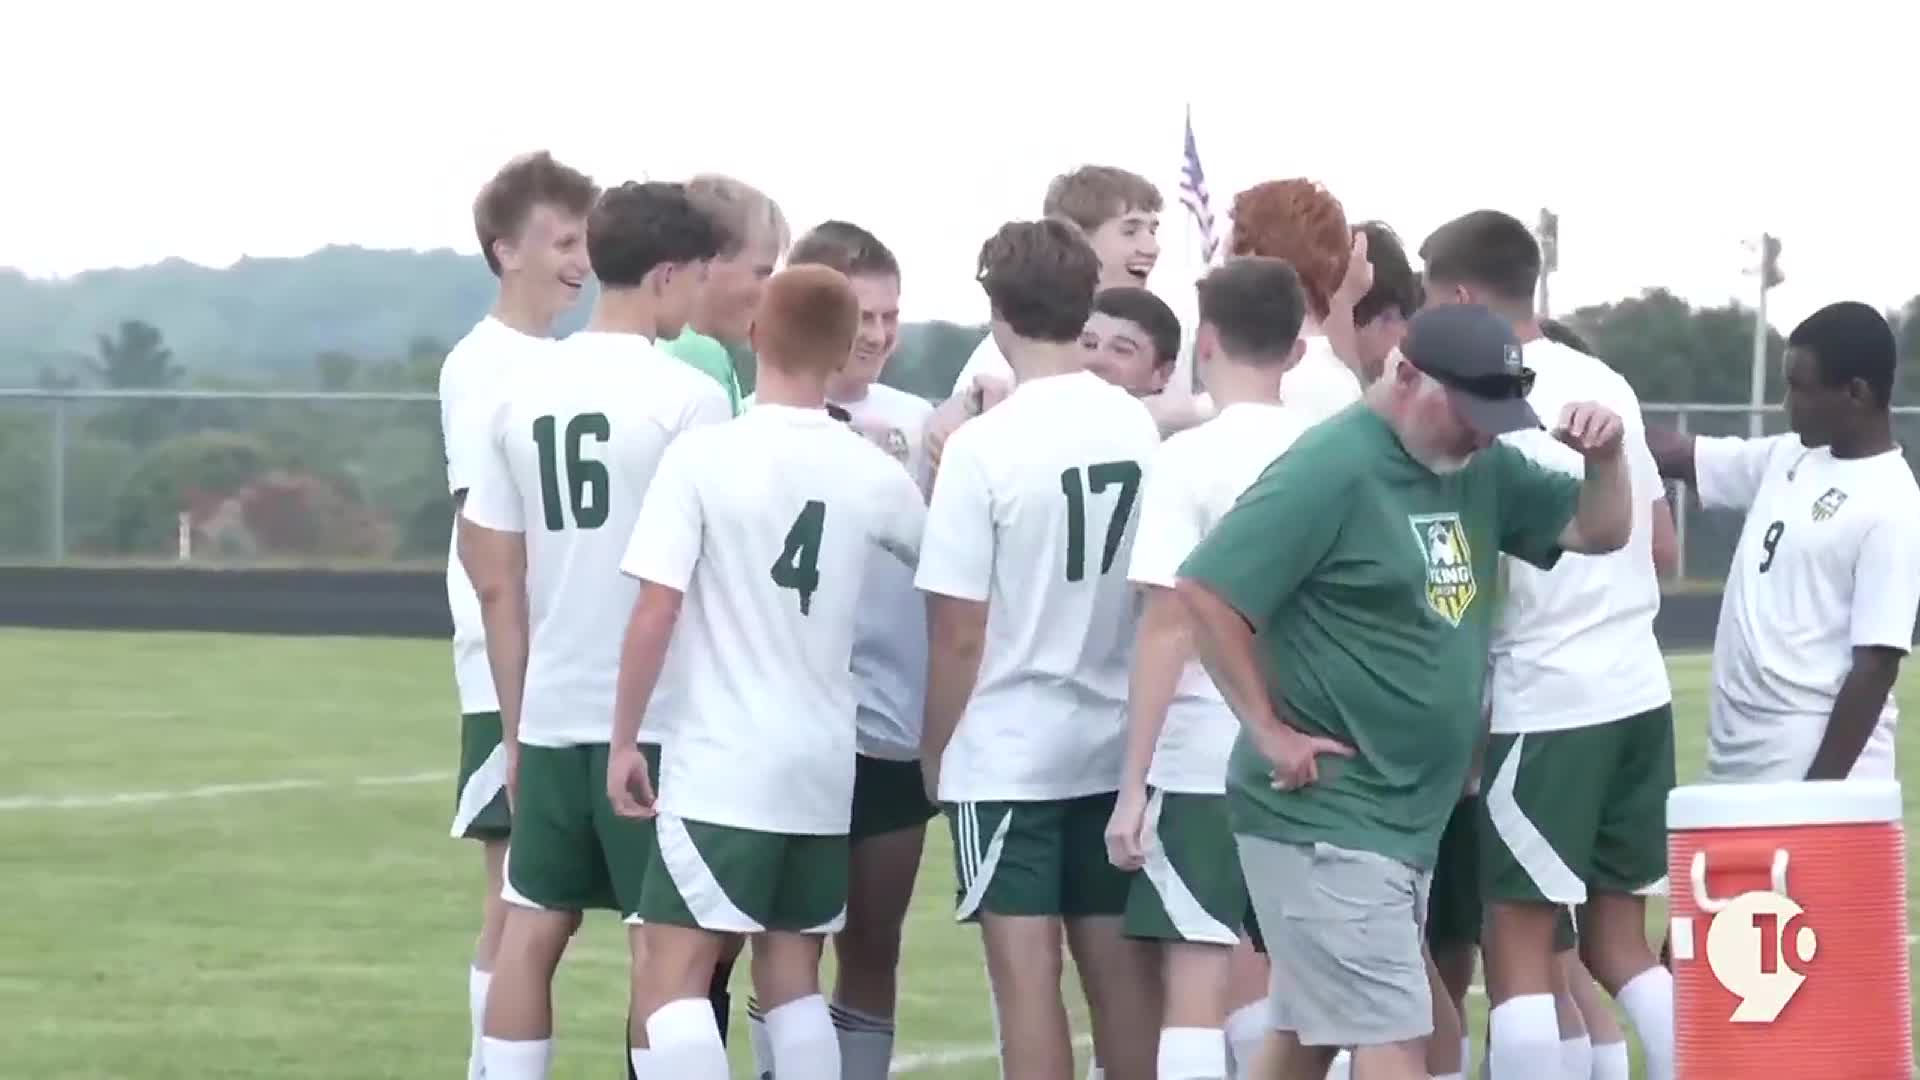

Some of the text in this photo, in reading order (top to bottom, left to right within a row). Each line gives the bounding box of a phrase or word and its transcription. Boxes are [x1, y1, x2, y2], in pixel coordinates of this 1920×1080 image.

[532, 412, 610, 531] 16
[1061, 460, 1142, 582] 17
[770, 500, 826, 616] 4
[1759, 520, 1784, 573] 9
